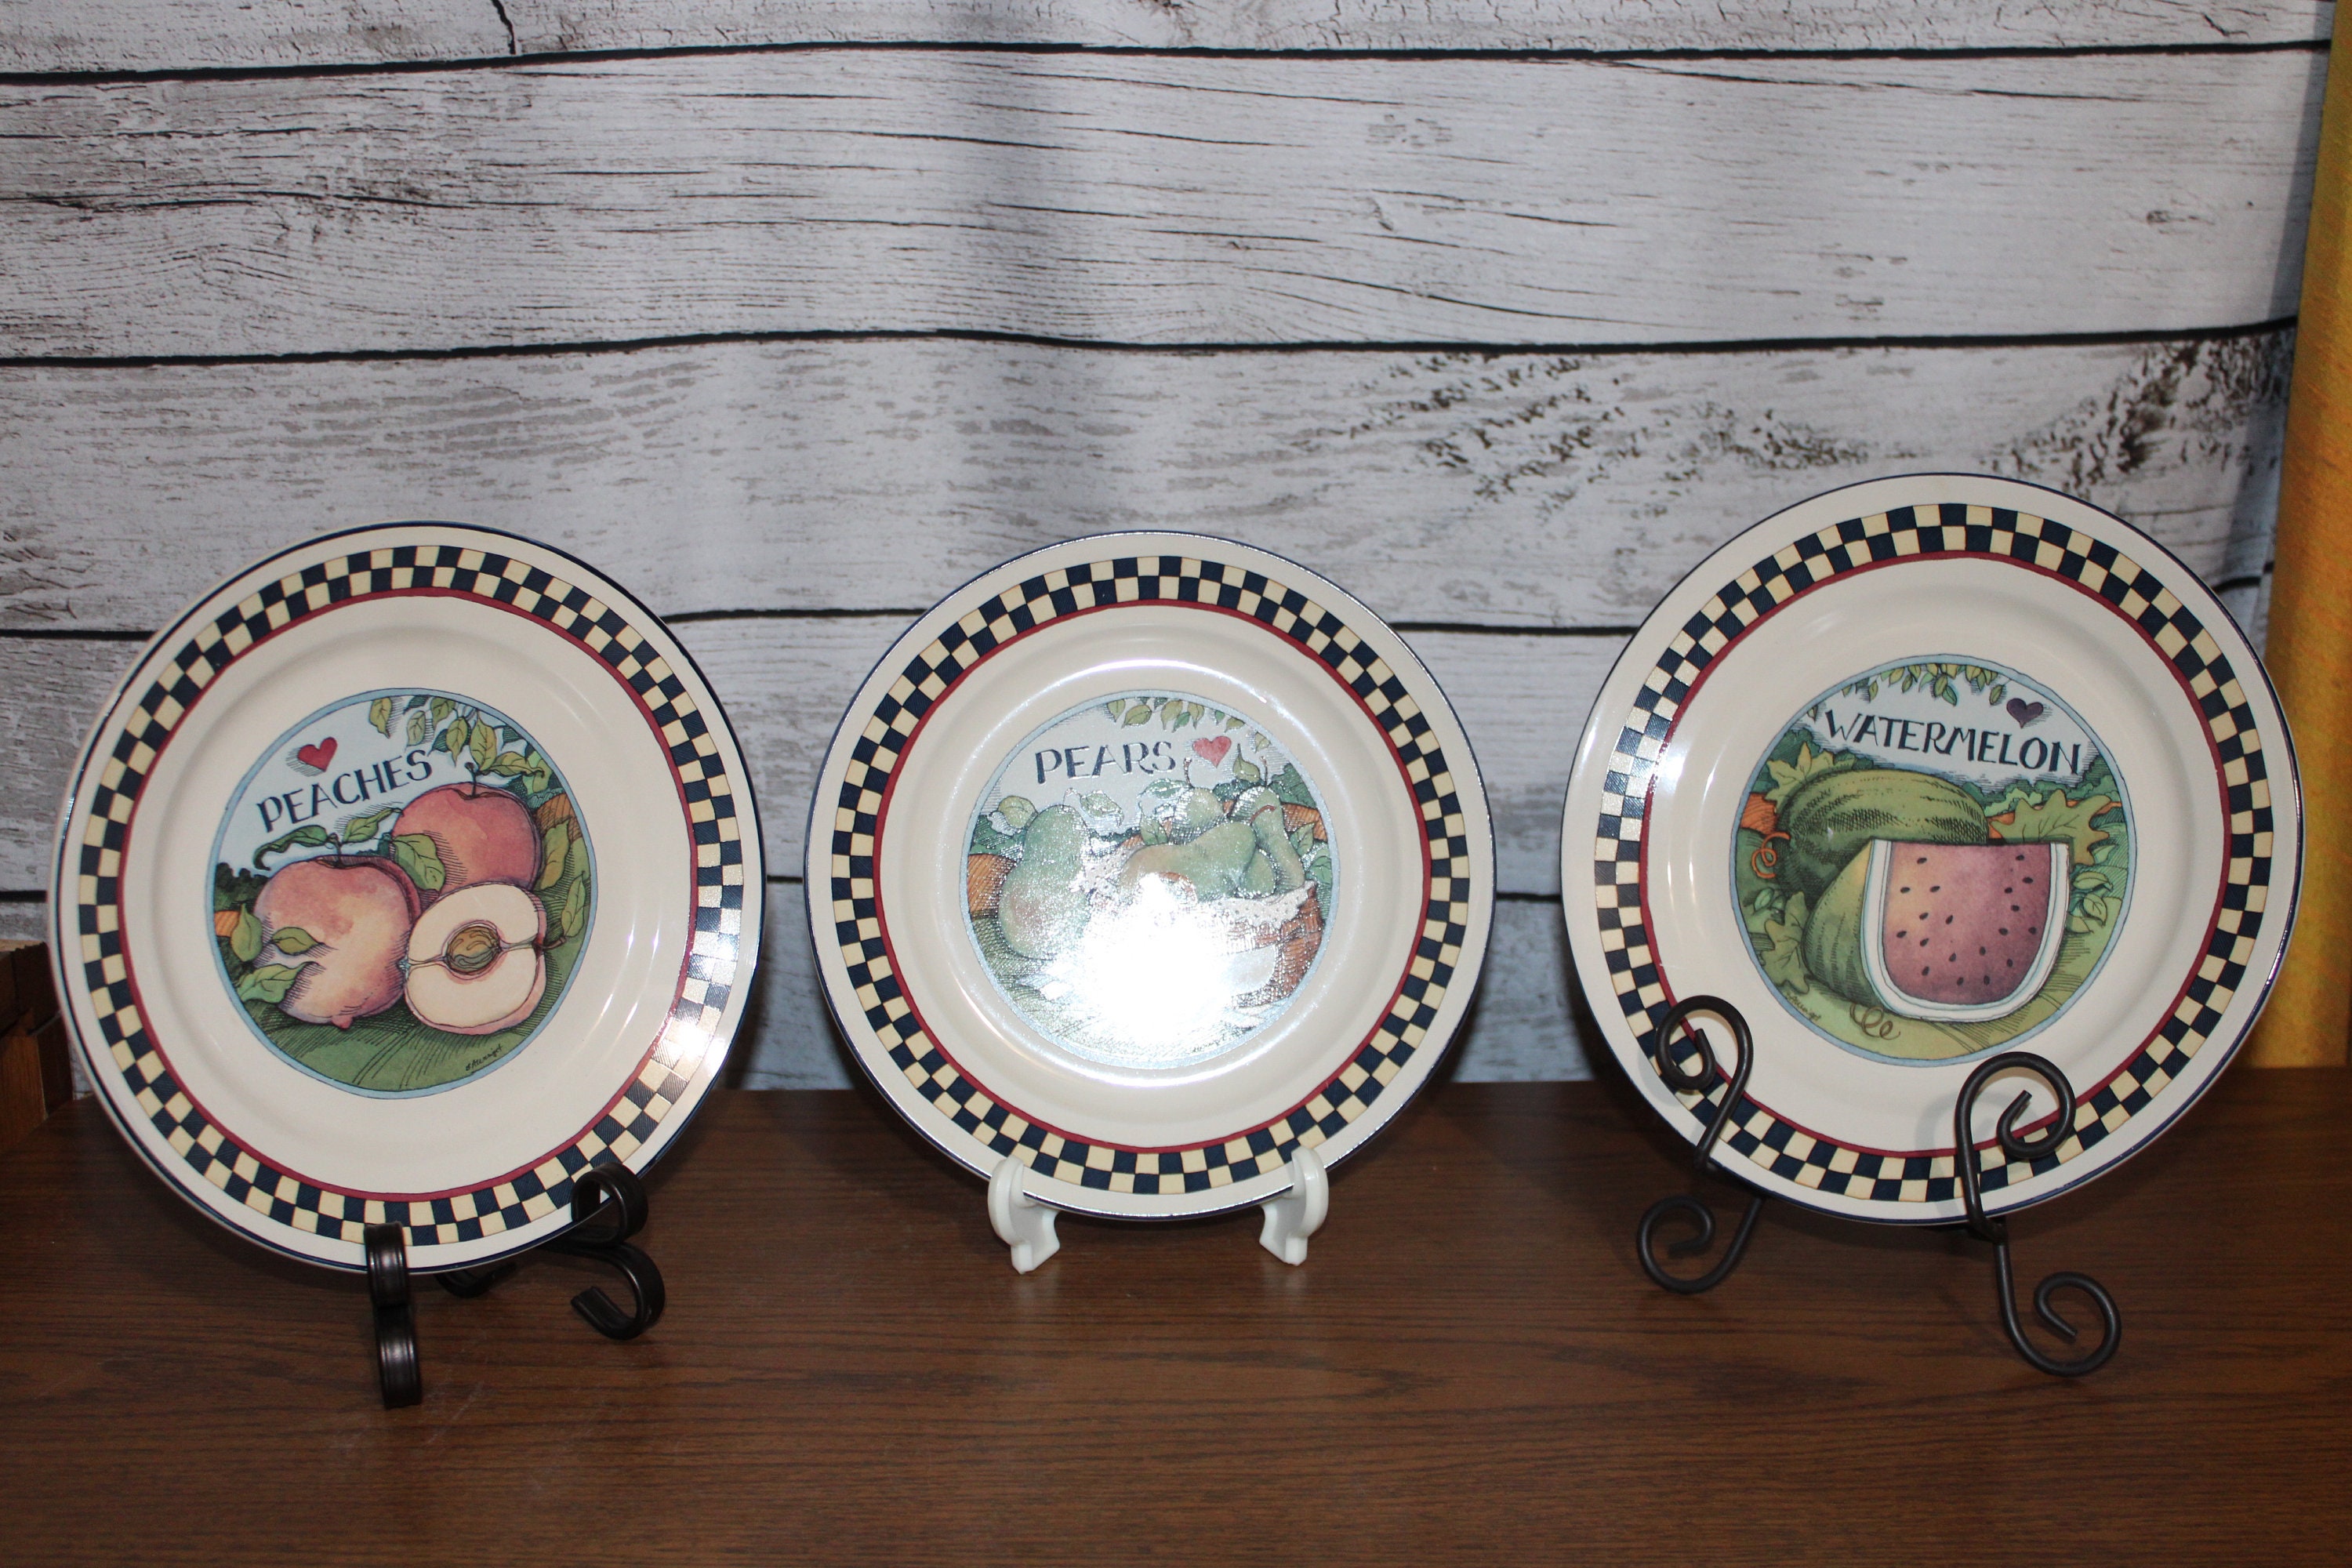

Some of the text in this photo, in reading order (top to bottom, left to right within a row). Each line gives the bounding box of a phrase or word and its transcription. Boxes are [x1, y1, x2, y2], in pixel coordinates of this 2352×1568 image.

[1035, 741, 1176, 785] PEARS
[1825, 709, 2082, 775] WATERMELON
[256, 750, 433, 833] PEACHES
